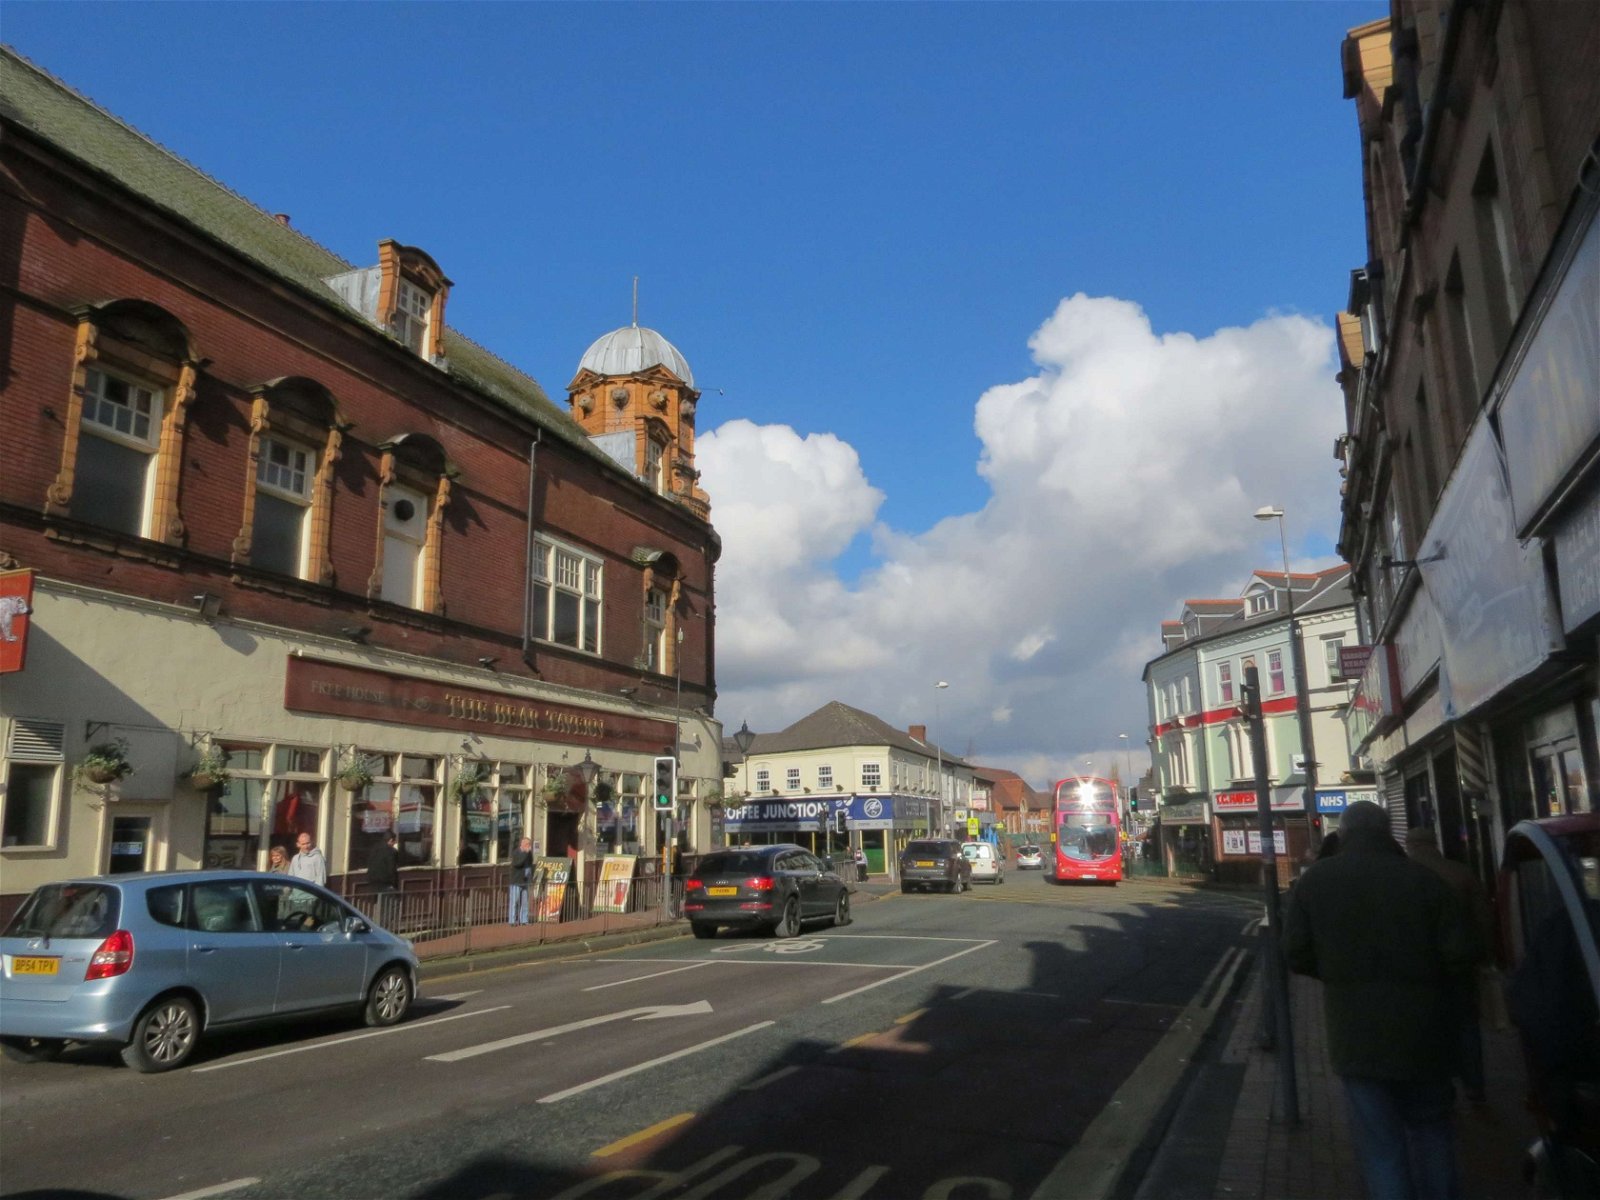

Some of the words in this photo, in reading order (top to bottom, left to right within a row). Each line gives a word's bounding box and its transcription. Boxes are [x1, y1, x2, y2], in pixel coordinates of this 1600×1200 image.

[346, 684, 385, 702] HOUSE
[445, 693, 488, 722] THE
[494, 702, 540, 728] BEAR
[545, 710, 604, 738] TAVERN
[1320, 796, 1343, 807] NHS
[724, 804, 760, 819] OFFEE
